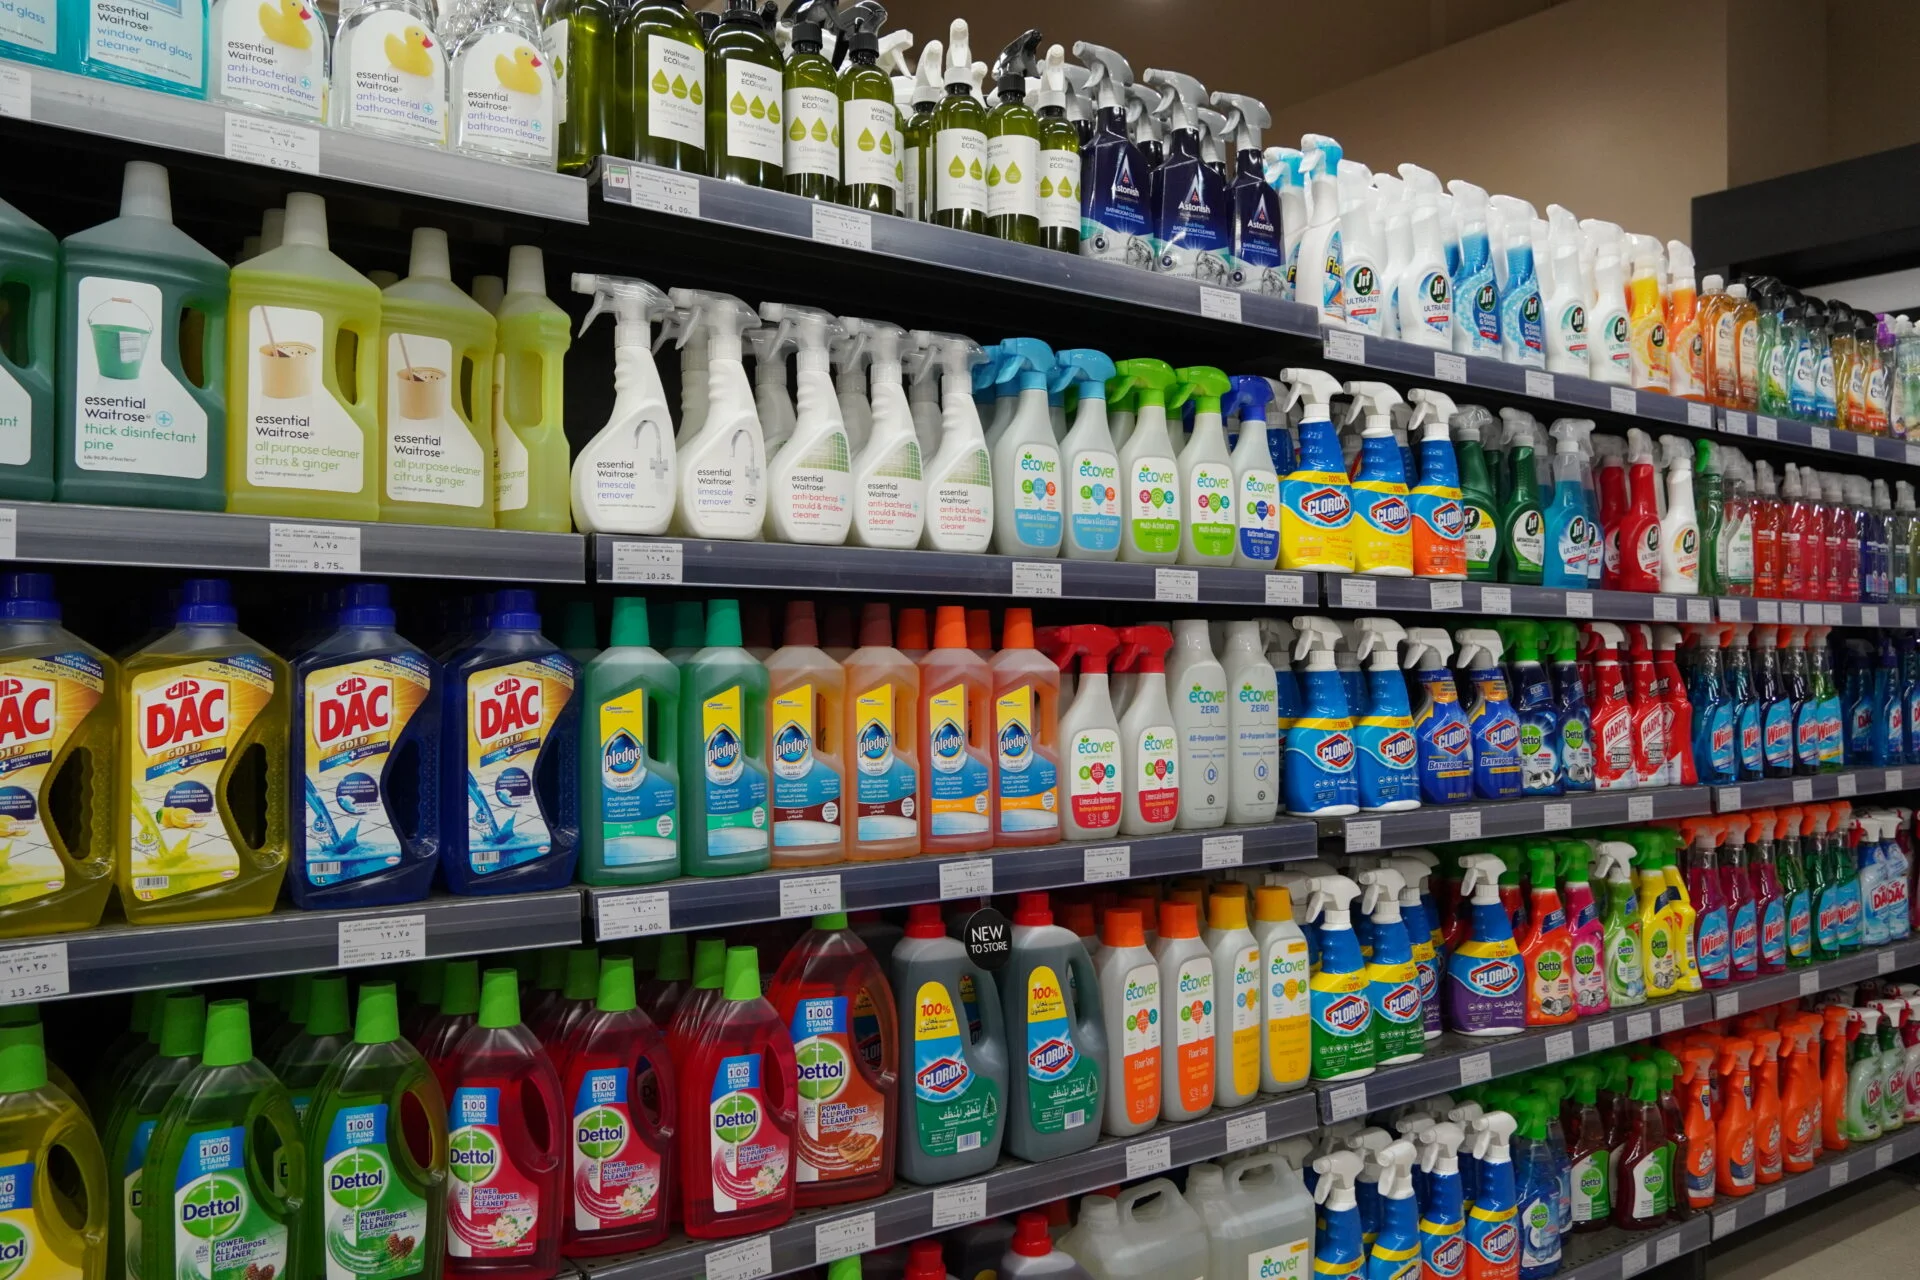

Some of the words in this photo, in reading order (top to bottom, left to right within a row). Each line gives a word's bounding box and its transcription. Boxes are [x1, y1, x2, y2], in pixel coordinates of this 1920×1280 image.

[16, 7, 46, 24] glass
[97, 2, 149, 21] essential
[97, 12, 149, 32] Waitrose
[97, 27, 142, 42] window
[145, 37, 167, 51] and
[169, 44, 193, 61] glass
[97, 38, 141, 54] cleaner
[228, 40, 274, 56] essential
[228, 50, 273, 66] Waitrose
[663, 48, 691, 61] Waitrose
[356, 70, 399, 84] essential
[741, 71, 768, 83] Waitrose
[356, 80, 399, 94] Waitrose
[356, 92, 420, 111] anti-bacterial
[467, 90, 509, 102] essential
[802, 94, 829, 104] Waitrose
[467, 100, 508, 112] Waitrose
[355, 102, 405, 119] bathroom
[407, 112, 439, 127] cleaner
[467, 121, 513, 136] bathroom
[516, 130, 546, 143] cleaner
[269, 157, 298, 170] 6.75
[1112, 184, 1140, 198] Astonish
[1178, 201, 1211, 214] Astonish
[1247, 220, 1274, 232] Astonish
[84, 395, 146, 410] essential
[84, 408, 146, 423] Waitrose
[255, 413, 310, 428] essential
[84, 422, 118, 437] thick
[120, 425, 197, 444] disinfectant
[255, 426, 310, 440] Waitrose
[394, 433, 441, 447] essential
[84, 438, 114, 453] pine
[255, 441, 269, 453] all
[270, 444, 320, 459] purpose
[322, 445, 361, 459] cleaner
[394, 445, 441, 458] Waitrose
[394, 460, 406, 470] all
[408, 462, 449, 475] purpose
[450, 465, 481, 477] cleaner
[597, 460, 634, 470] essential
[697, 467, 732, 477] essential
[1021, 458, 1056, 473] ecover
[1079, 463, 1116, 479] ecover
[597, 469, 635, 479] Waitrose
[697, 476, 732, 486] Waitrose
[792, 474, 824, 484] essential
[1138, 469, 1174, 484] ecover
[597, 480, 636, 491] limescale
[792, 483, 824, 492] Waitrose
[867, 482, 898, 491] essential
[1197, 476, 1230, 489] ecover
[1246, 480, 1276, 494] ecover
[597, 490, 634, 500] remover
[697, 487, 734, 497] limescale
[868, 490, 899, 499] Waitrose
[697, 497, 732, 507] remover
[1307, 494, 1348, 515] CLOROX
[792, 510, 821, 520] cleaner
[868, 517, 896, 526] cleaner
[1376, 506, 1410, 525] CLOROX
[940, 522, 966, 531] cleaner
[313, 561, 340, 571] 8.75
[645, 572, 672, 581] 10.25
[54, 656, 103, 678] MULTI-PURPOSE
[227, 657, 274, 680] MULTI-PURPOSE
[391, 656, 430, 677] MULTI-PURPOSE
[336, 677, 367, 696] داك
[1189, 689, 1227, 705] ecover
[1239, 688, 1277, 704] ecover
[319, 685, 389, 743] DAC
[480, 684, 540, 740] DAC
[1200, 705, 1220, 714] ZERO
[1251, 704, 1270, 713] ZERO
[147, 686, 225, 750] DAC
[1490, 724, 1519, 746] CLOROX
[1565, 729, 1585, 740] Dettol
[1605, 716, 1628, 743] HARPIC
[337, 736, 369, 752] GOLD
[495, 734, 523, 748] GOLD
[1143, 737, 1174, 752] ecover
[1438, 727, 1469, 748] CLOROX
[168, 742, 202, 759] GOLD
[708, 741, 740, 766] pledge
[776, 738, 809, 762] pledge
[859, 735, 891, 758] pledge
[934, 735, 965, 757] pledge
[1000, 735, 1029, 757] pledge
[1078, 740, 1116, 755] ecover
[1322, 739, 1351, 761] CLOROX
[1385, 736, 1414, 759] CLOROX
[604, 746, 641, 772] pledge
[971, 924, 1004, 943] NEW
[971, 944, 982, 954] TO
[983, 940, 1008, 953] STORE
[1618, 946, 1634, 955] Dettol
[380, 949, 412, 961] 12.75
[1575, 955, 1596, 966] Dettol
[1271, 958, 1306, 975] ecover
[1537, 961, 1561, 972] Dettol
[1180, 973, 1212, 993] ecover
[1476, 967, 1515, 986] CLOROX
[10, 984, 51, 998] 13.25
[1032, 986, 1058, 1000] 100%
[1126, 982, 1158, 1001] ecover
[1388, 990, 1419, 1011] CLOROX
[807, 1006, 833, 1018] 100
[921, 1002, 951, 1017] 100%
[1331, 1001, 1369, 1024] CLOROX
[806, 1019, 834, 1028] STAINS
[1035, 1043, 1070, 1069] CLOROX
[728, 1077, 750, 1085] STAINS
[923, 1062, 963, 1087] CLOROX
[462, 1111, 487, 1119] STAINS
[821, 1103, 846, 1112] POWER
[715, 1110, 757, 1127] Dettol
[821, 1116, 853, 1126] CLEANER
[346, 1130, 374, 1140] STAINS
[578, 1126, 623, 1142] Dettol
[201, 1144, 229, 1157] 100
[450, 1149, 494, 1165] Dettol
[200, 1155, 231, 1166] STAINS
[331, 1169, 383, 1191] Dettol
[1581, 1176, 1601, 1188] Dettol
[1644, 1175, 1663, 1185] Dettol
[183, 1196, 240, 1221] Dettol
[474, 1200, 504, 1208] CLEANER
[360, 1209, 386, 1218] POWER
[1530, 1212, 1549, 1222] Dettol
[360, 1221, 393, 1232] CLEANER
[215, 1238, 244, 1249] POWER
[1486, 1227, 1516, 1254] CLOROX
[215, 1250, 251, 1263] CLEANER
[1438, 1240, 1465, 1267] CLOROX
[1260, 1255, 1299, 1278] ecover
